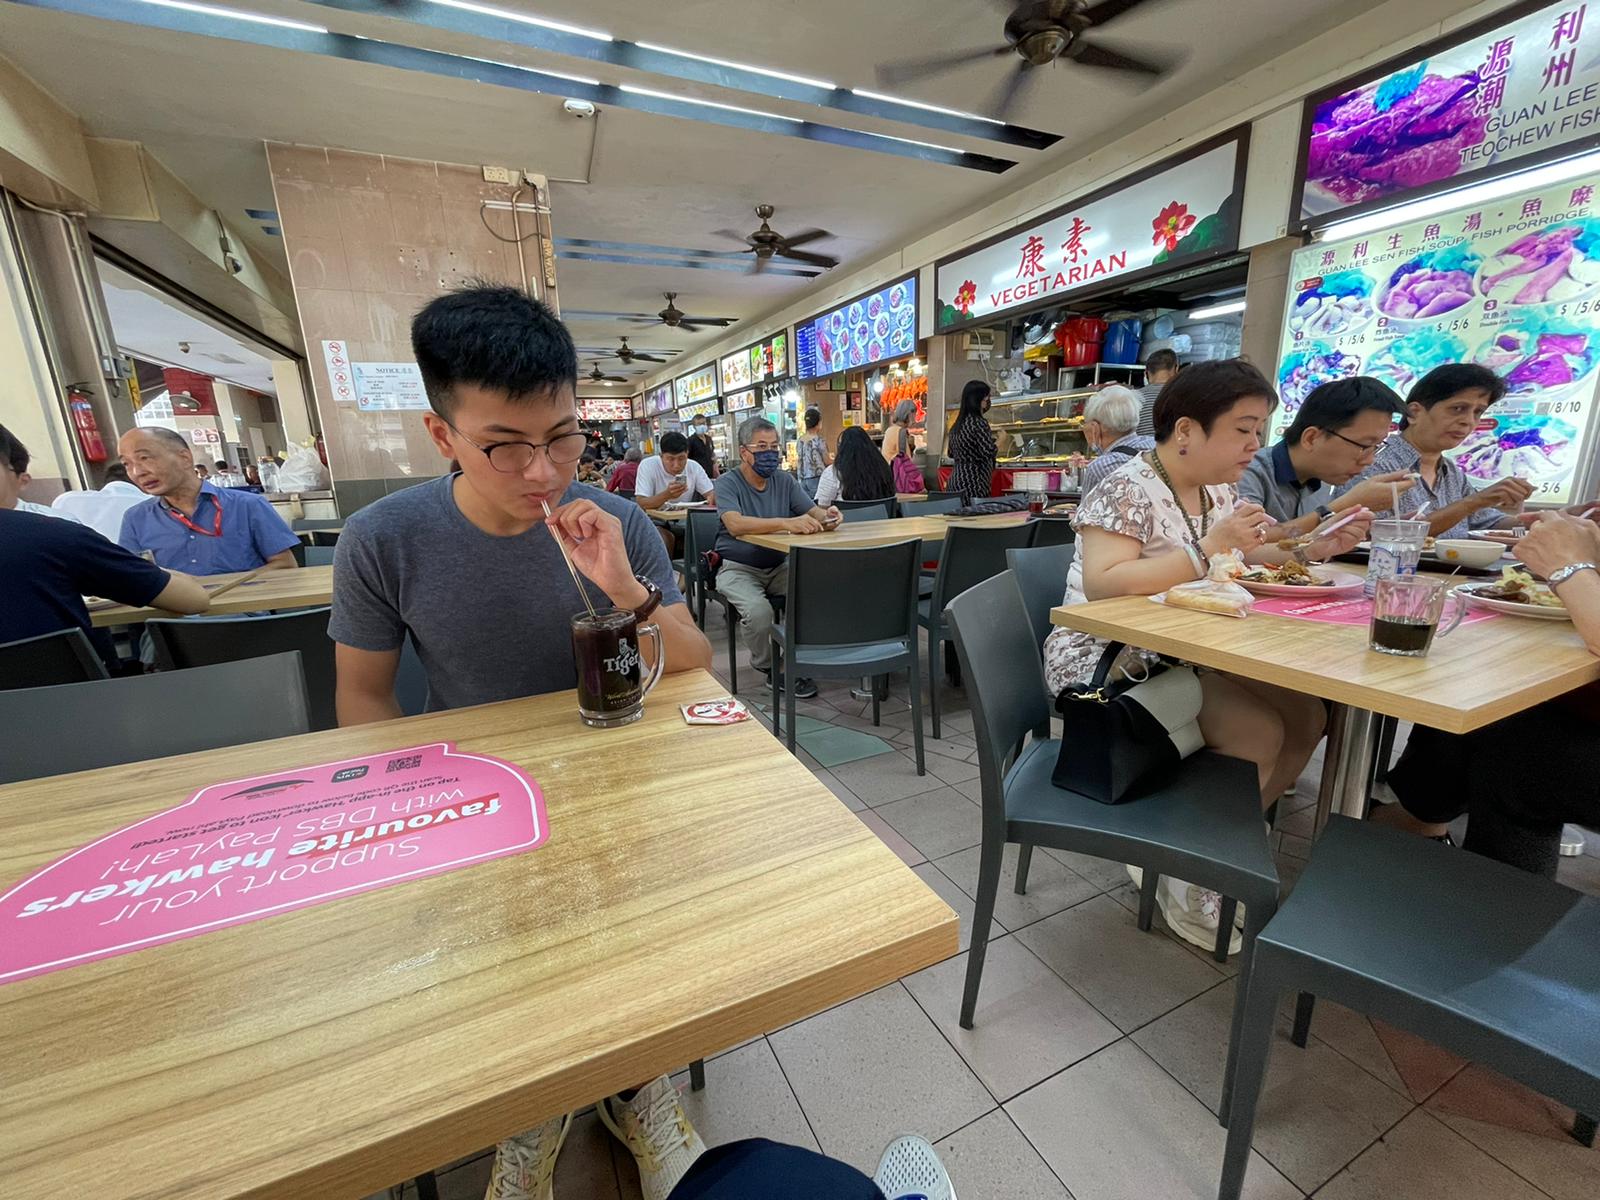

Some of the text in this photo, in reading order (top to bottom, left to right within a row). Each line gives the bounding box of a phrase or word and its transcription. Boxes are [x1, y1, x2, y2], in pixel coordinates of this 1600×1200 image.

[1485, 82, 1599, 133] GUAN LEE
[1460, 121, 1556, 163] TEOCHEW
[1317, 264, 1347, 277] GUAN
[1350, 258, 1369, 269] LEE
[1372, 253, 1395, 264] SEN
[1398, 246, 1425, 258] FISH
[1471, 228, 1503, 241] FISH
[1506, 207, 1589, 233] PORRIDGE
[990, 250, 1127, 307] VEGETARIAN
[603, 653, 640, 675] Tiger
[16, 800, 502, 918] favourite hawkers
[100, 789, 464, 880] with DBS PayLah!
[98, 836, 422, 926] Support your
